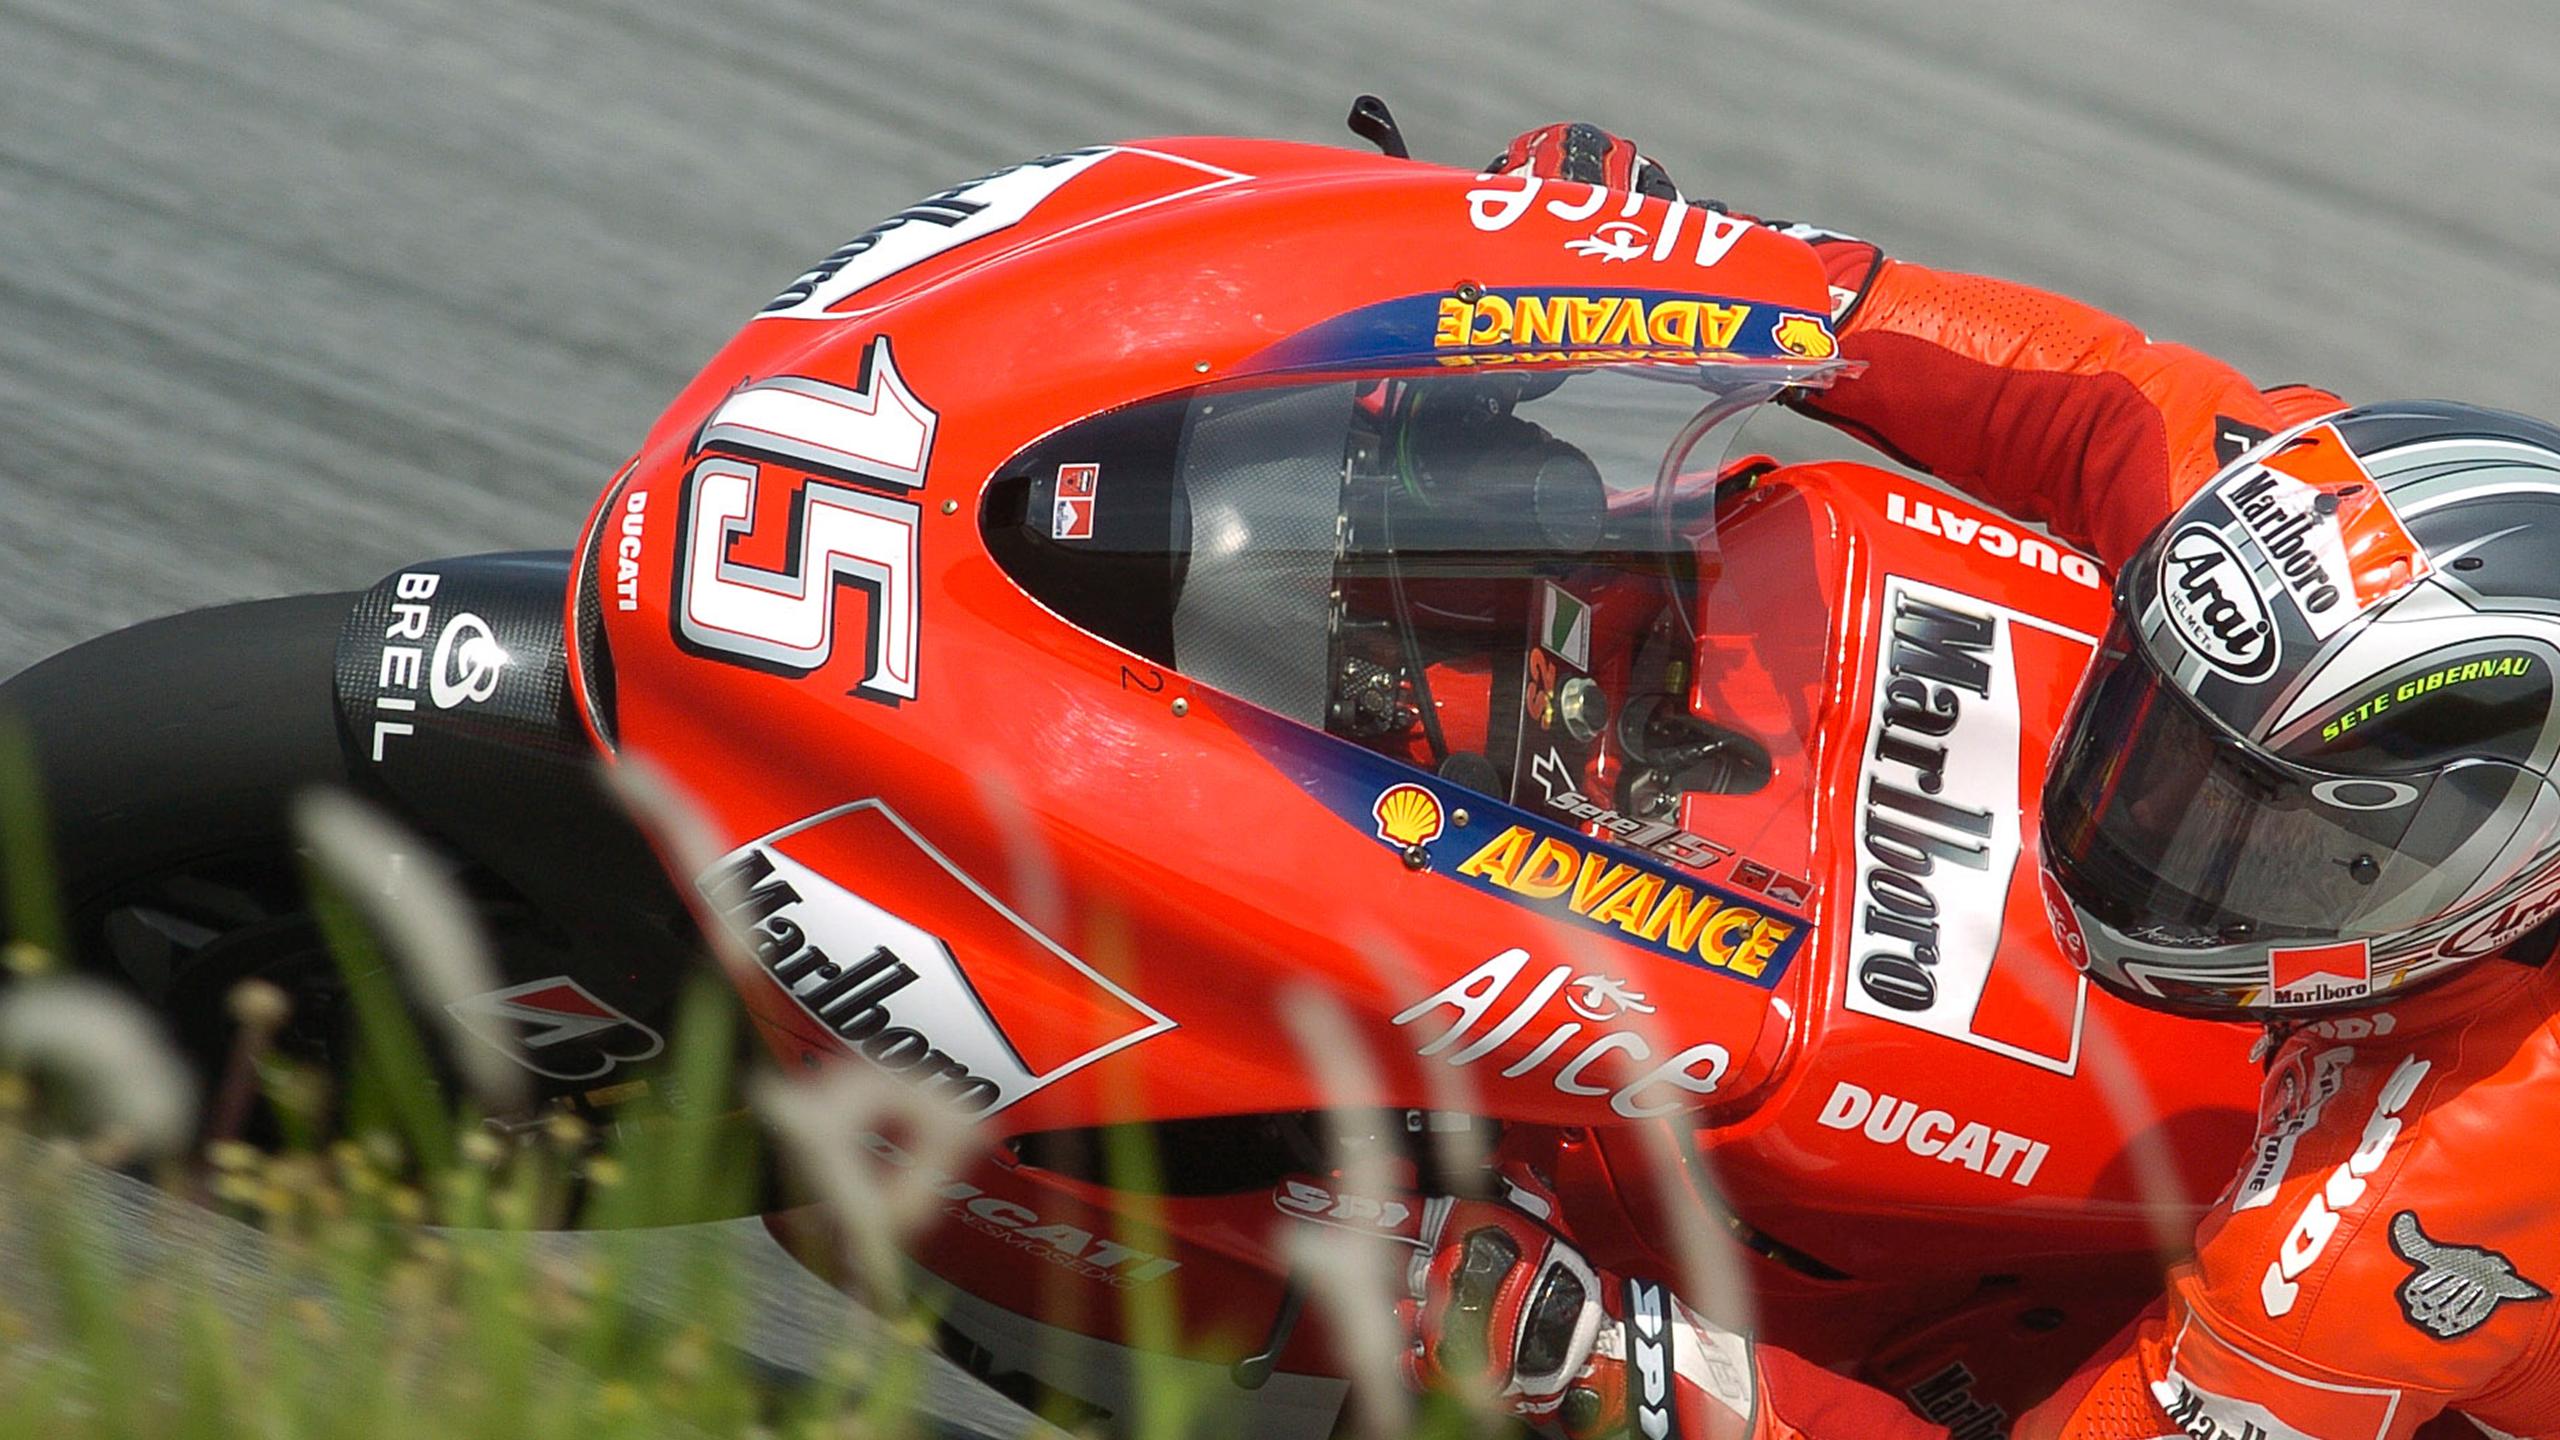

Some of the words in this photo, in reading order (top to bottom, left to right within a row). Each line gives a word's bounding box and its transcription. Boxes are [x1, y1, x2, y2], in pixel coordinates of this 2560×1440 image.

[1434, 296, 1751, 348] ADVANCE
[616, 491, 648, 611] DUCATI
[670, 335, 939, 708] 15
[1886, 493, 2100, 589] DUCATI
[2228, 470, 2340, 614] Marlboro
[2167, 551, 2270, 656] Arai
[2170, 592, 2208, 645] HELMET
[373, 573, 440, 762] BREIL
[2322, 693, 2391, 743] SETE
[2396, 657, 2533, 703] GIBERNAU
[1856, 589, 1996, 1013] Marlboro
[1456, 825, 1795, 978] ADVANCE
[704, 848, 1002, 1113] Marlboro
[1391, 947, 1730, 1119] Alice
[2274, 983, 2367, 1004] Marlboro
[1817, 1081, 2050, 1187] DUCATI
